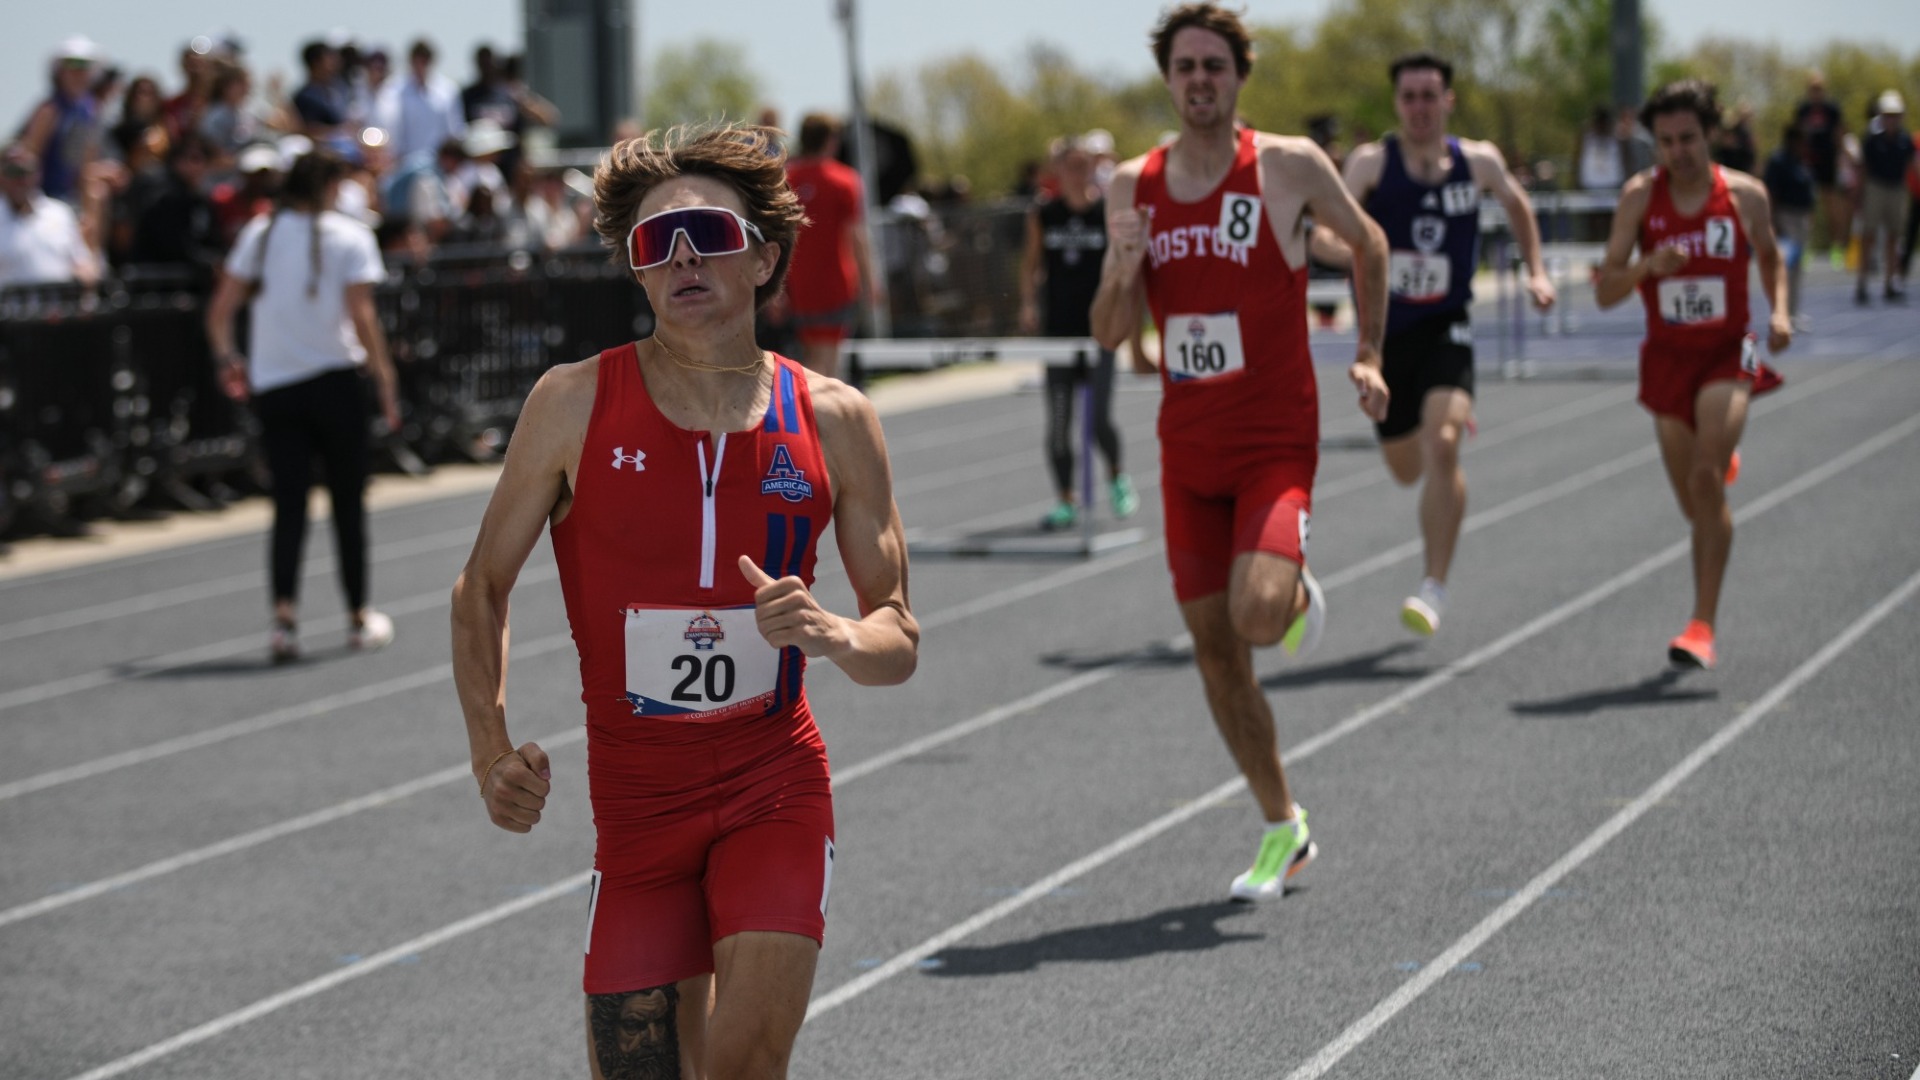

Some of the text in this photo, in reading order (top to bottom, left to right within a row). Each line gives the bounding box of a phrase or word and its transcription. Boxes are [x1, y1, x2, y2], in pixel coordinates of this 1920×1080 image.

[1228, 198, 1253, 241] 8
[1713, 222, 1729, 256] 2
[1178, 341, 1226, 373] 160
[764, 480, 810, 493] AMERICAN
[671, 654, 735, 703] 20
[690, 711, 718, 719] COLLEGE
